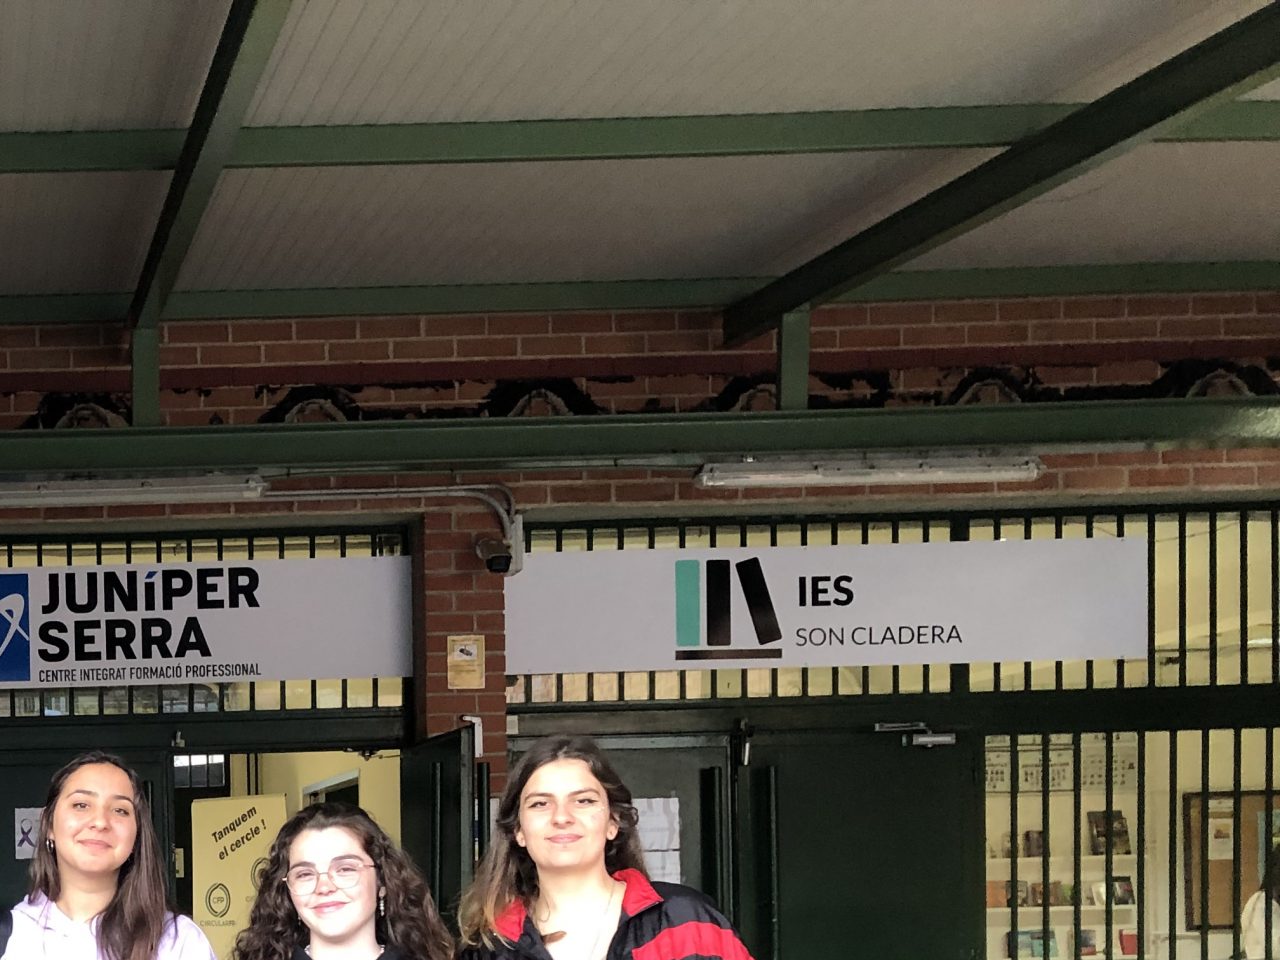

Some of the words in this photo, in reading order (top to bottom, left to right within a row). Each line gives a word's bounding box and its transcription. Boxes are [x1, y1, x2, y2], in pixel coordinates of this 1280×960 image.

[798, 575, 854, 607] IES
[37, 616, 212, 663] SERRA
[795, 627, 845, 647] SON
[851, 624, 963, 646] CLADERA
[38, 668, 77, 683] CENTRE
[79, 667, 127, 681] INTEGRAT
[129, 663, 182, 680] FORMACIÓ
[185, 663, 262, 679] PROFESSIONAL
[211, 806, 257, 843] Tanquem
[218, 848, 229, 860] el
[229, 825, 261, 853] cercle
